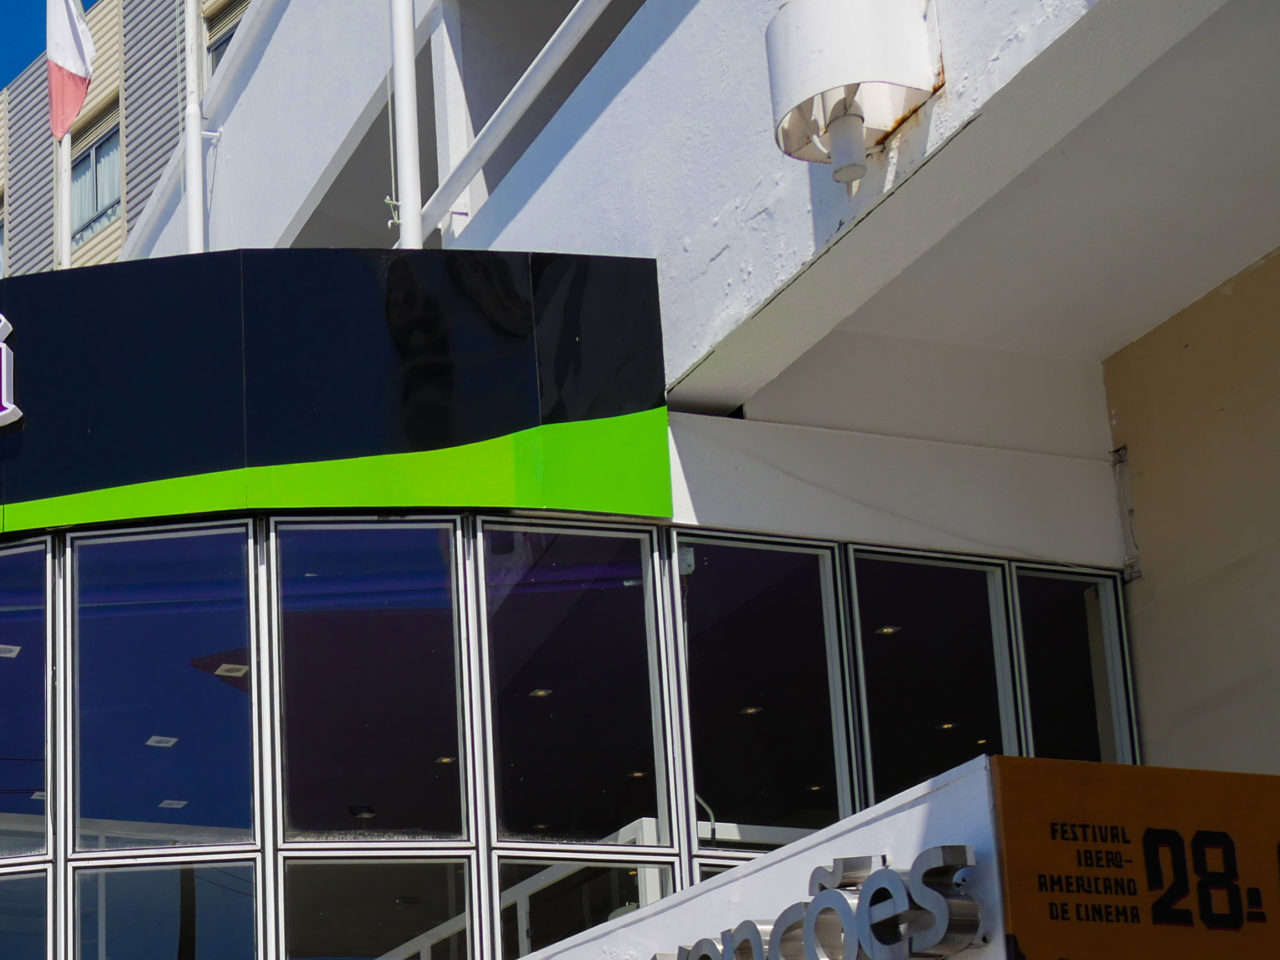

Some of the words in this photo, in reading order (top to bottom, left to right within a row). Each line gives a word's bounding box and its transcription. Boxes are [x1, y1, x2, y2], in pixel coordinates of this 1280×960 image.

[1049, 821, 1131, 844] FESTIVAL
[1076, 848, 1133, 868] IBERO-
[1037, 873, 1137, 896] AMERICANO
[1048, 902, 1071, 921] DE
[1076, 902, 1141, 923] CINEMA
